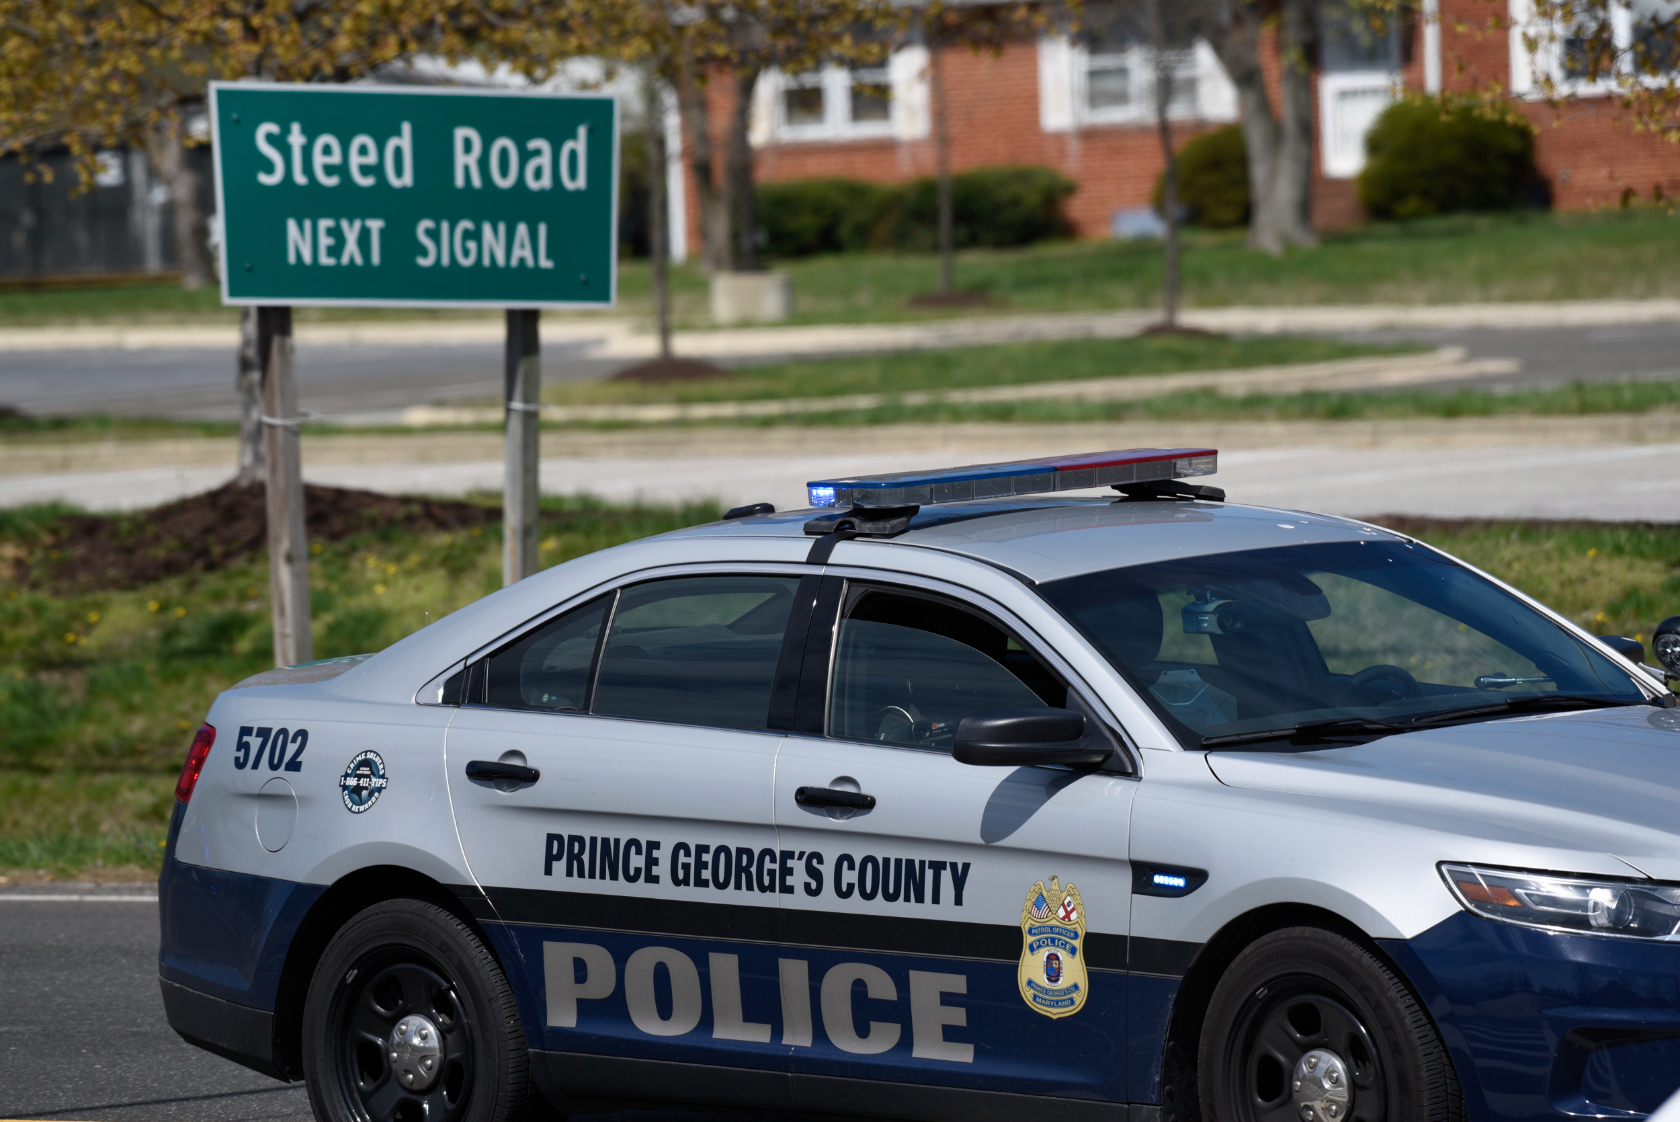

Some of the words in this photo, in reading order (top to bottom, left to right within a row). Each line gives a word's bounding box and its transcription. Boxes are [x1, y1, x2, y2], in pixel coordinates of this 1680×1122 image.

[255, 120, 413, 188] Steed
[453, 123, 589, 191] Road
[286, 217, 385, 267] NEXT
[415, 218, 554, 269] SIGNAL
[234, 726, 309, 772] 5702
[346, 752, 366, 774] CRIME
[366, 751, 385, 775] SOLVERS
[340, 776, 387, 787] 1-866-411-TIPS
[343, 790, 353, 809] CASH
[351, 791, 380, 812] REWARDS
[543, 832, 661, 884] PRINCE
[670, 841, 824, 897] GEORGE'S
[833, 853, 971, 907] COUNTY
[1031, 926, 1052, 935] PATROL
[1053, 927, 1075, 938] OFFICER
[1033, 938, 1073, 953] POLICE
[1031, 982, 1047, 993] PRINCE
[543, 941, 975, 1063] POLICE
[1035, 996, 1072, 1007] MARYLAND
